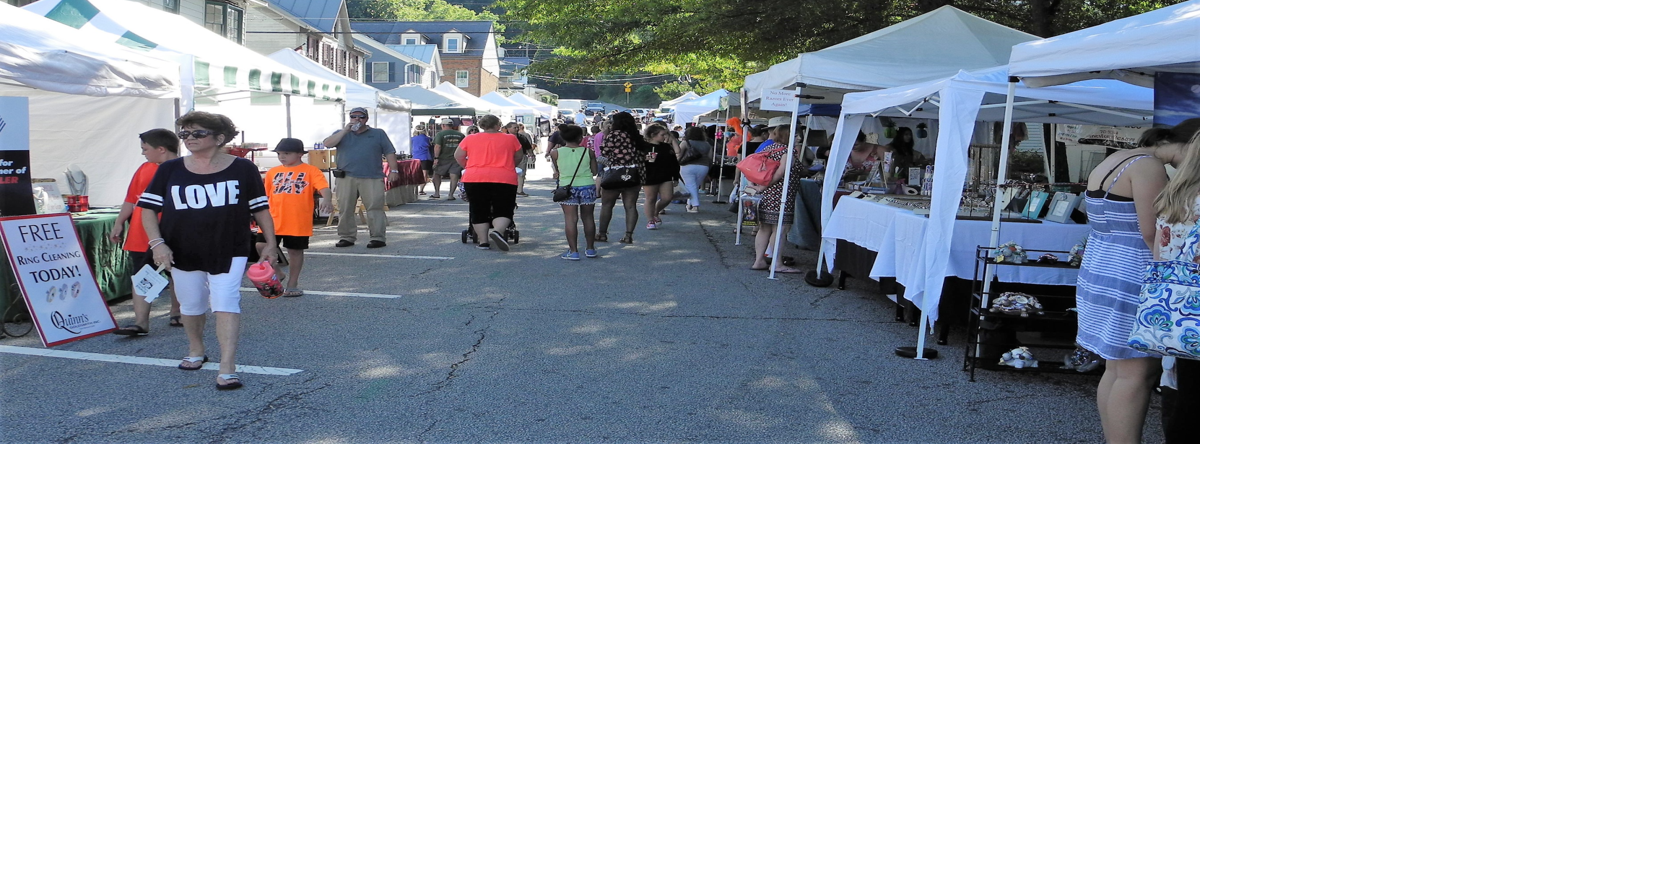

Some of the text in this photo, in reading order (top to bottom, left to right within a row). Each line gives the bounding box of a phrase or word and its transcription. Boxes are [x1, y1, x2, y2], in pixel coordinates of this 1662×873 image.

[15, 166, 27, 174] of
[171, 180, 240, 210] LOVE
[18, 222, 64, 243] FREE
[17, 250, 81, 266] RING CLEANING
[29, 265, 81, 283] TODAY!
[50, 310, 90, 334] Quinn's
